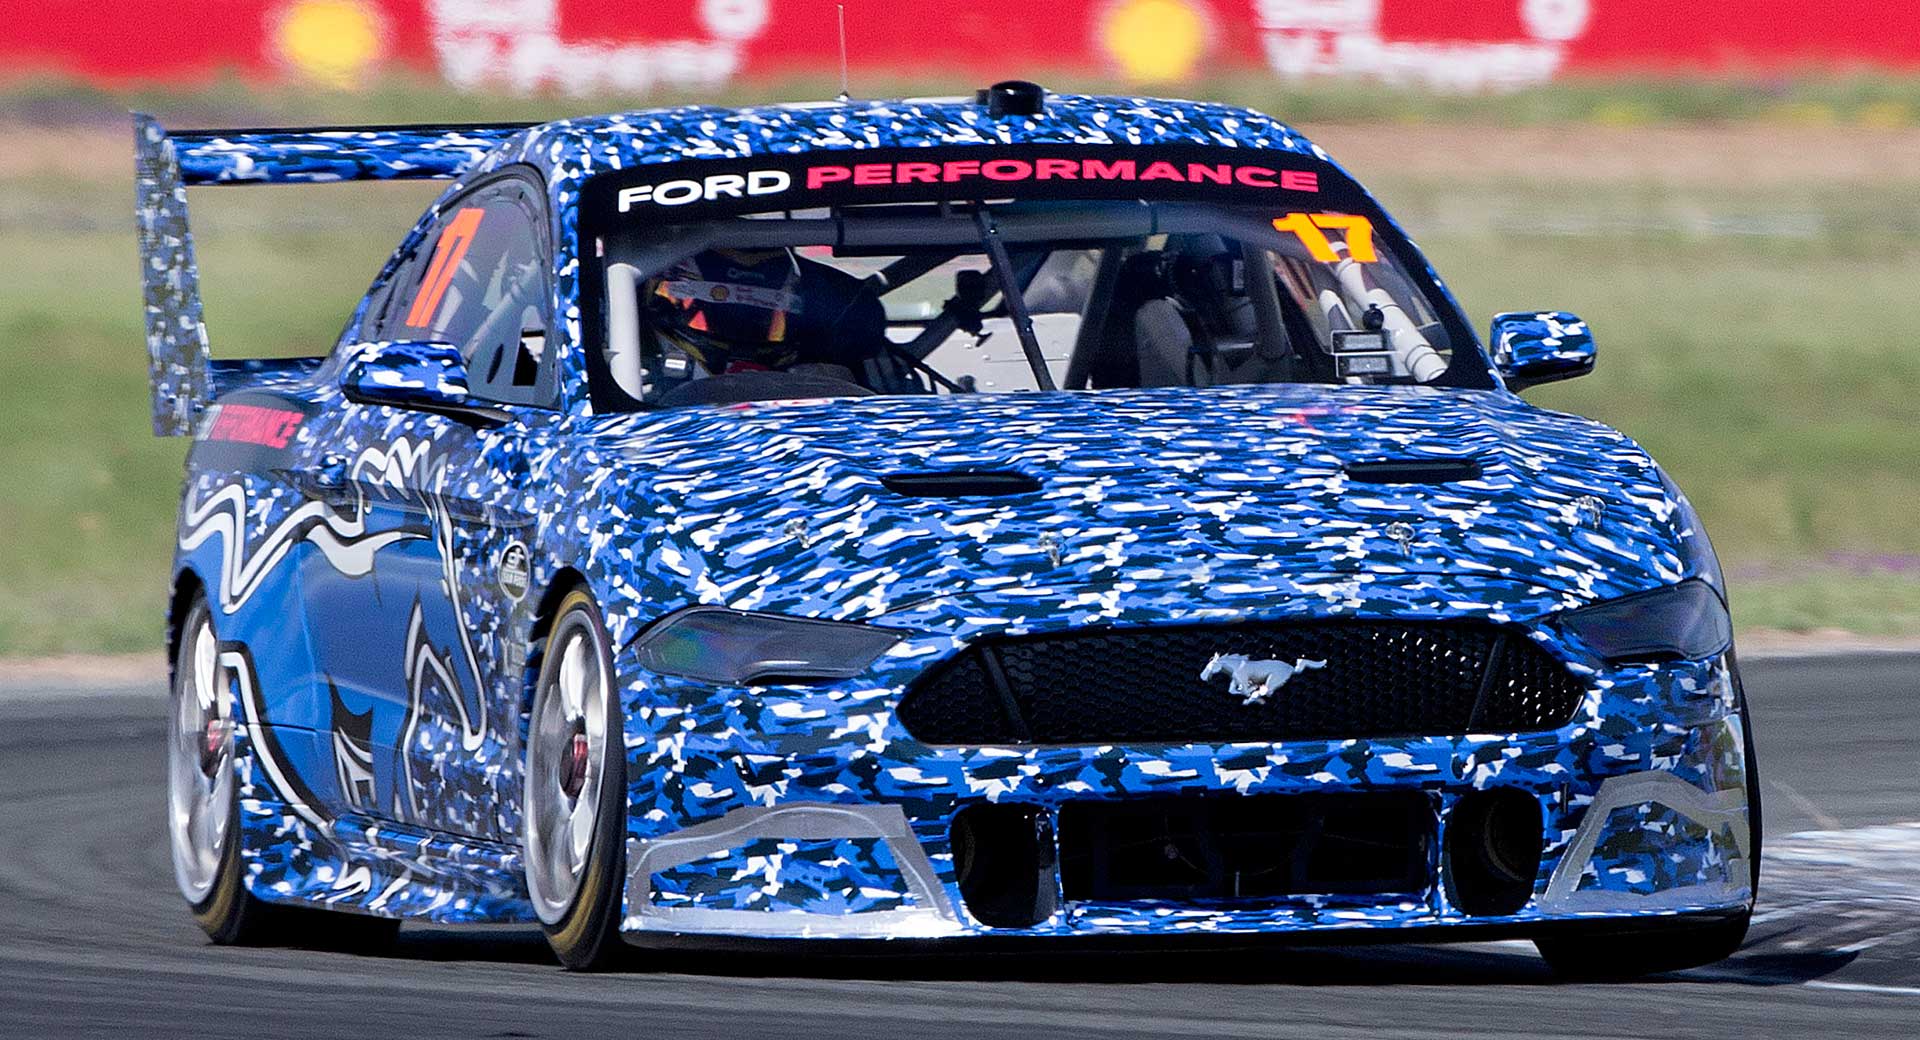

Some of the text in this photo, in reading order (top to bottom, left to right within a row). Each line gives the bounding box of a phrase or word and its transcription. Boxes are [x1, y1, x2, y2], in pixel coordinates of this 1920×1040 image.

[618, 158, 1319, 213] FORD PERFORMANCE
[1272, 212, 1377, 263] 17
